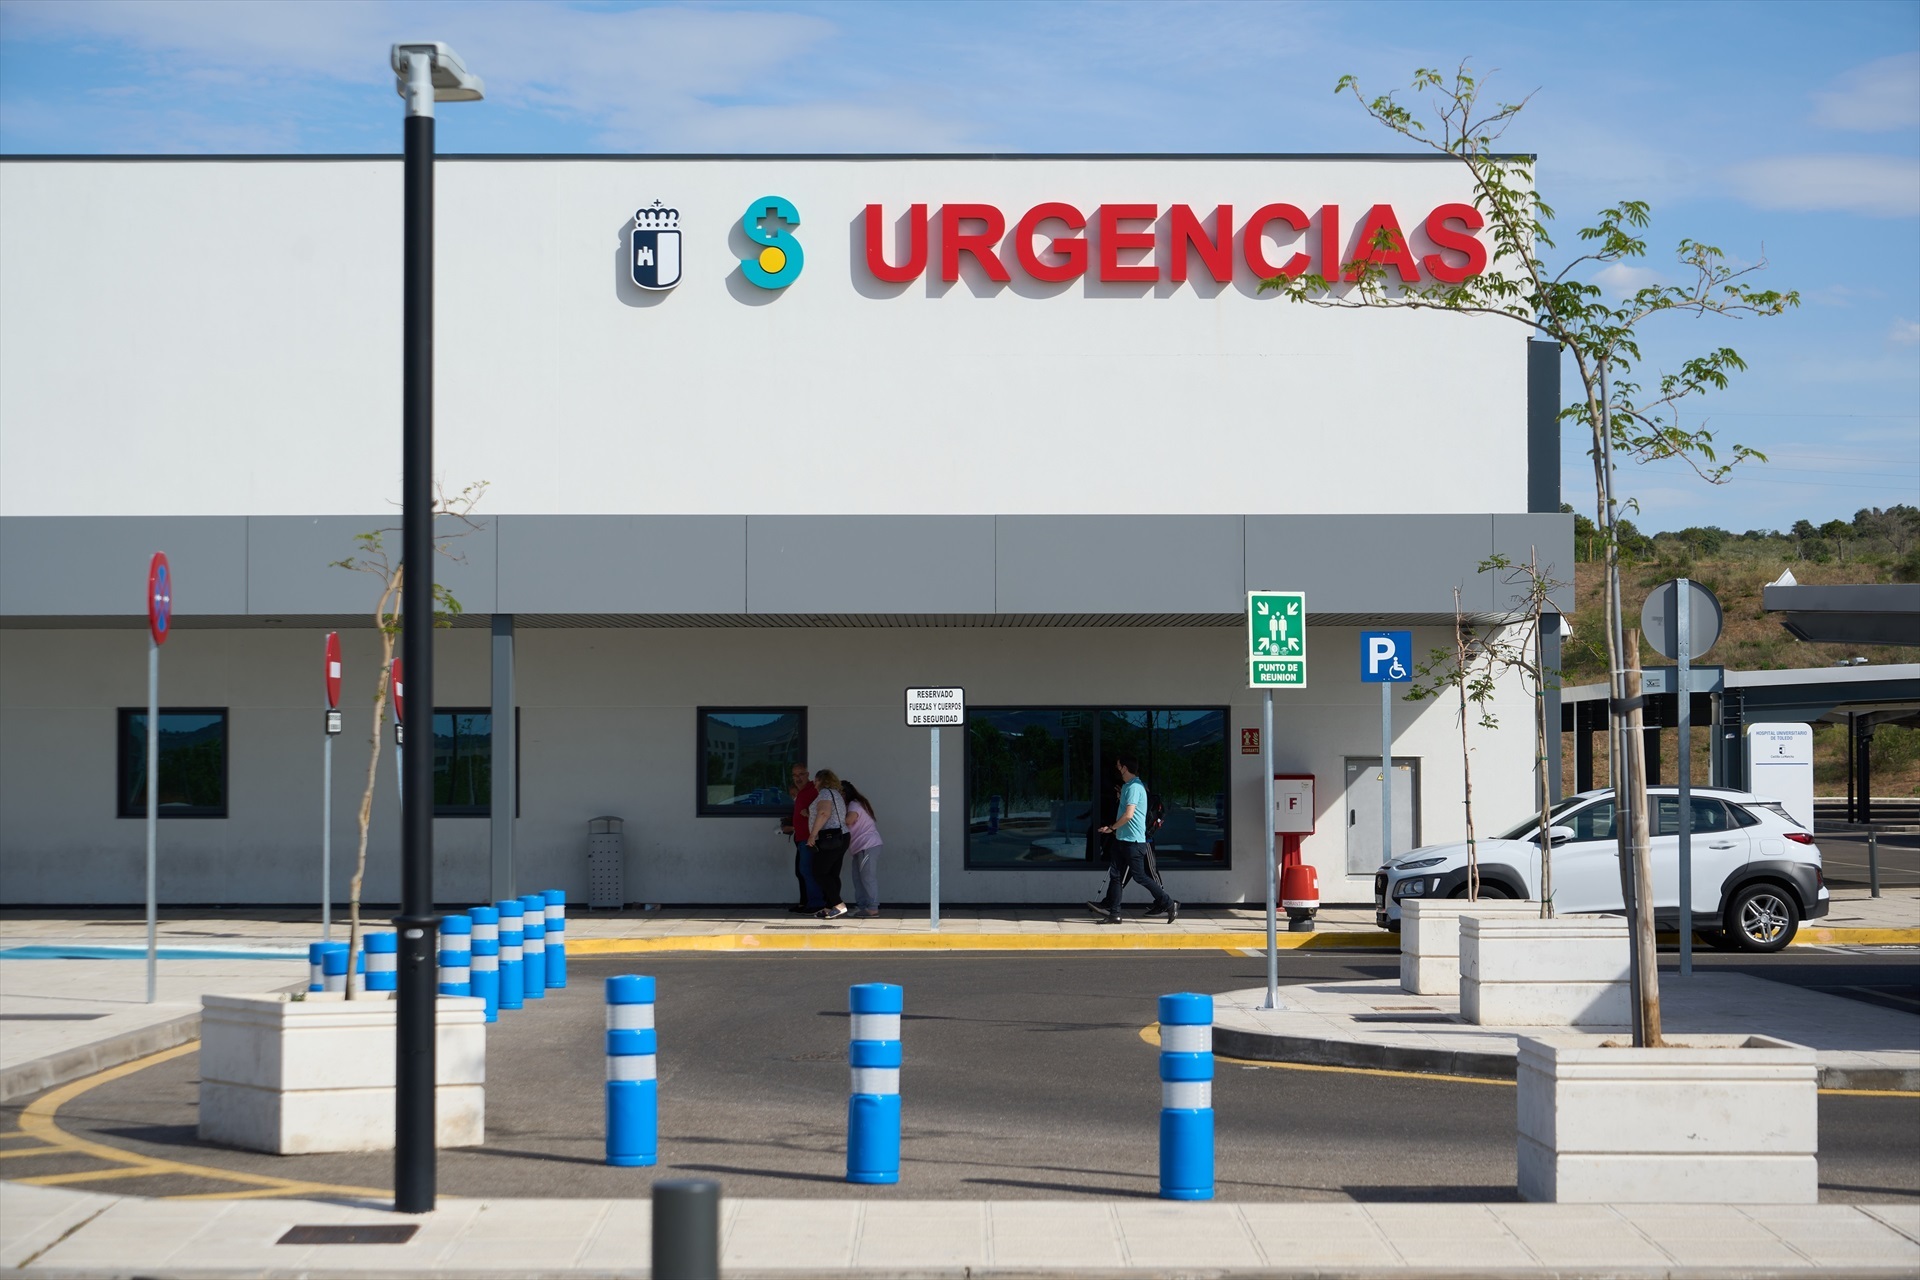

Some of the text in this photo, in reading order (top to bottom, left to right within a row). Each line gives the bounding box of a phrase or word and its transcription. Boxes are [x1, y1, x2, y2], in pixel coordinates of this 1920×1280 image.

[865, 202, 1487, 283] URGENCIAS
[1369, 637, 1396, 674] P
[1258, 663, 1298, 672] PUNTO DE
[1260, 673, 1297, 682] REUNION
[917, 690, 954, 698] RESERVADO
[909, 703, 932, 711] FUERZAS
[938, 702, 962, 710] CUERPOS
[922, 715, 958, 723] SEGURIDAD
[1289, 798, 1298, 810] F
